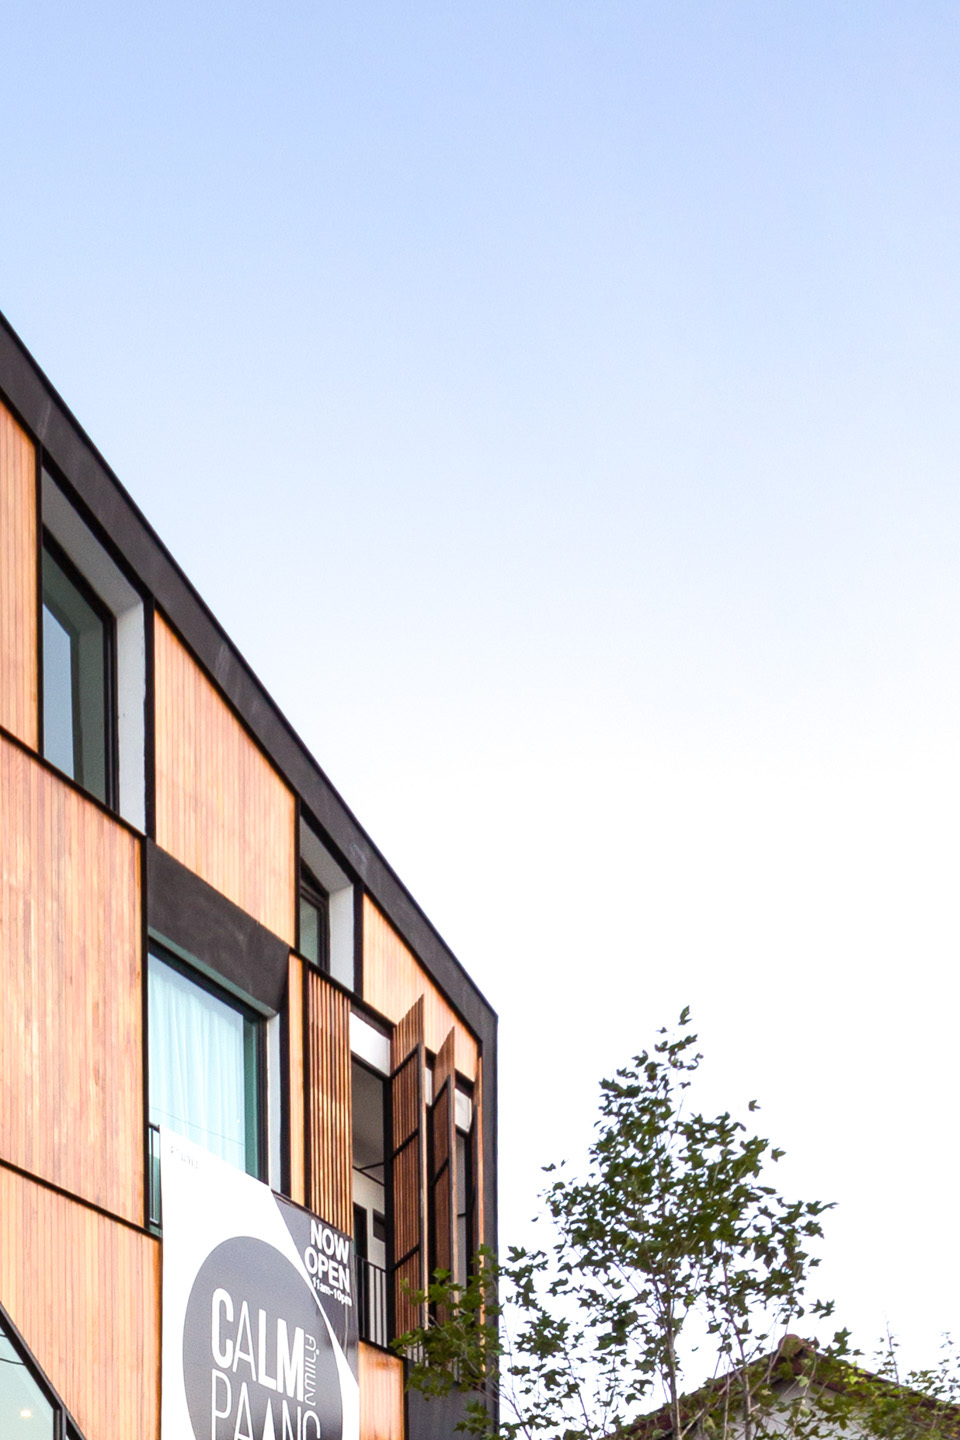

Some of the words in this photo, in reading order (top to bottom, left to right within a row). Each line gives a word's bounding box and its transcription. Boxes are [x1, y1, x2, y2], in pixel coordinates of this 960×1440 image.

[310, 1219, 350, 1265] NOW
[304, 1246, 350, 1293] OPEN
[211, 1288, 305, 1402] CALM
